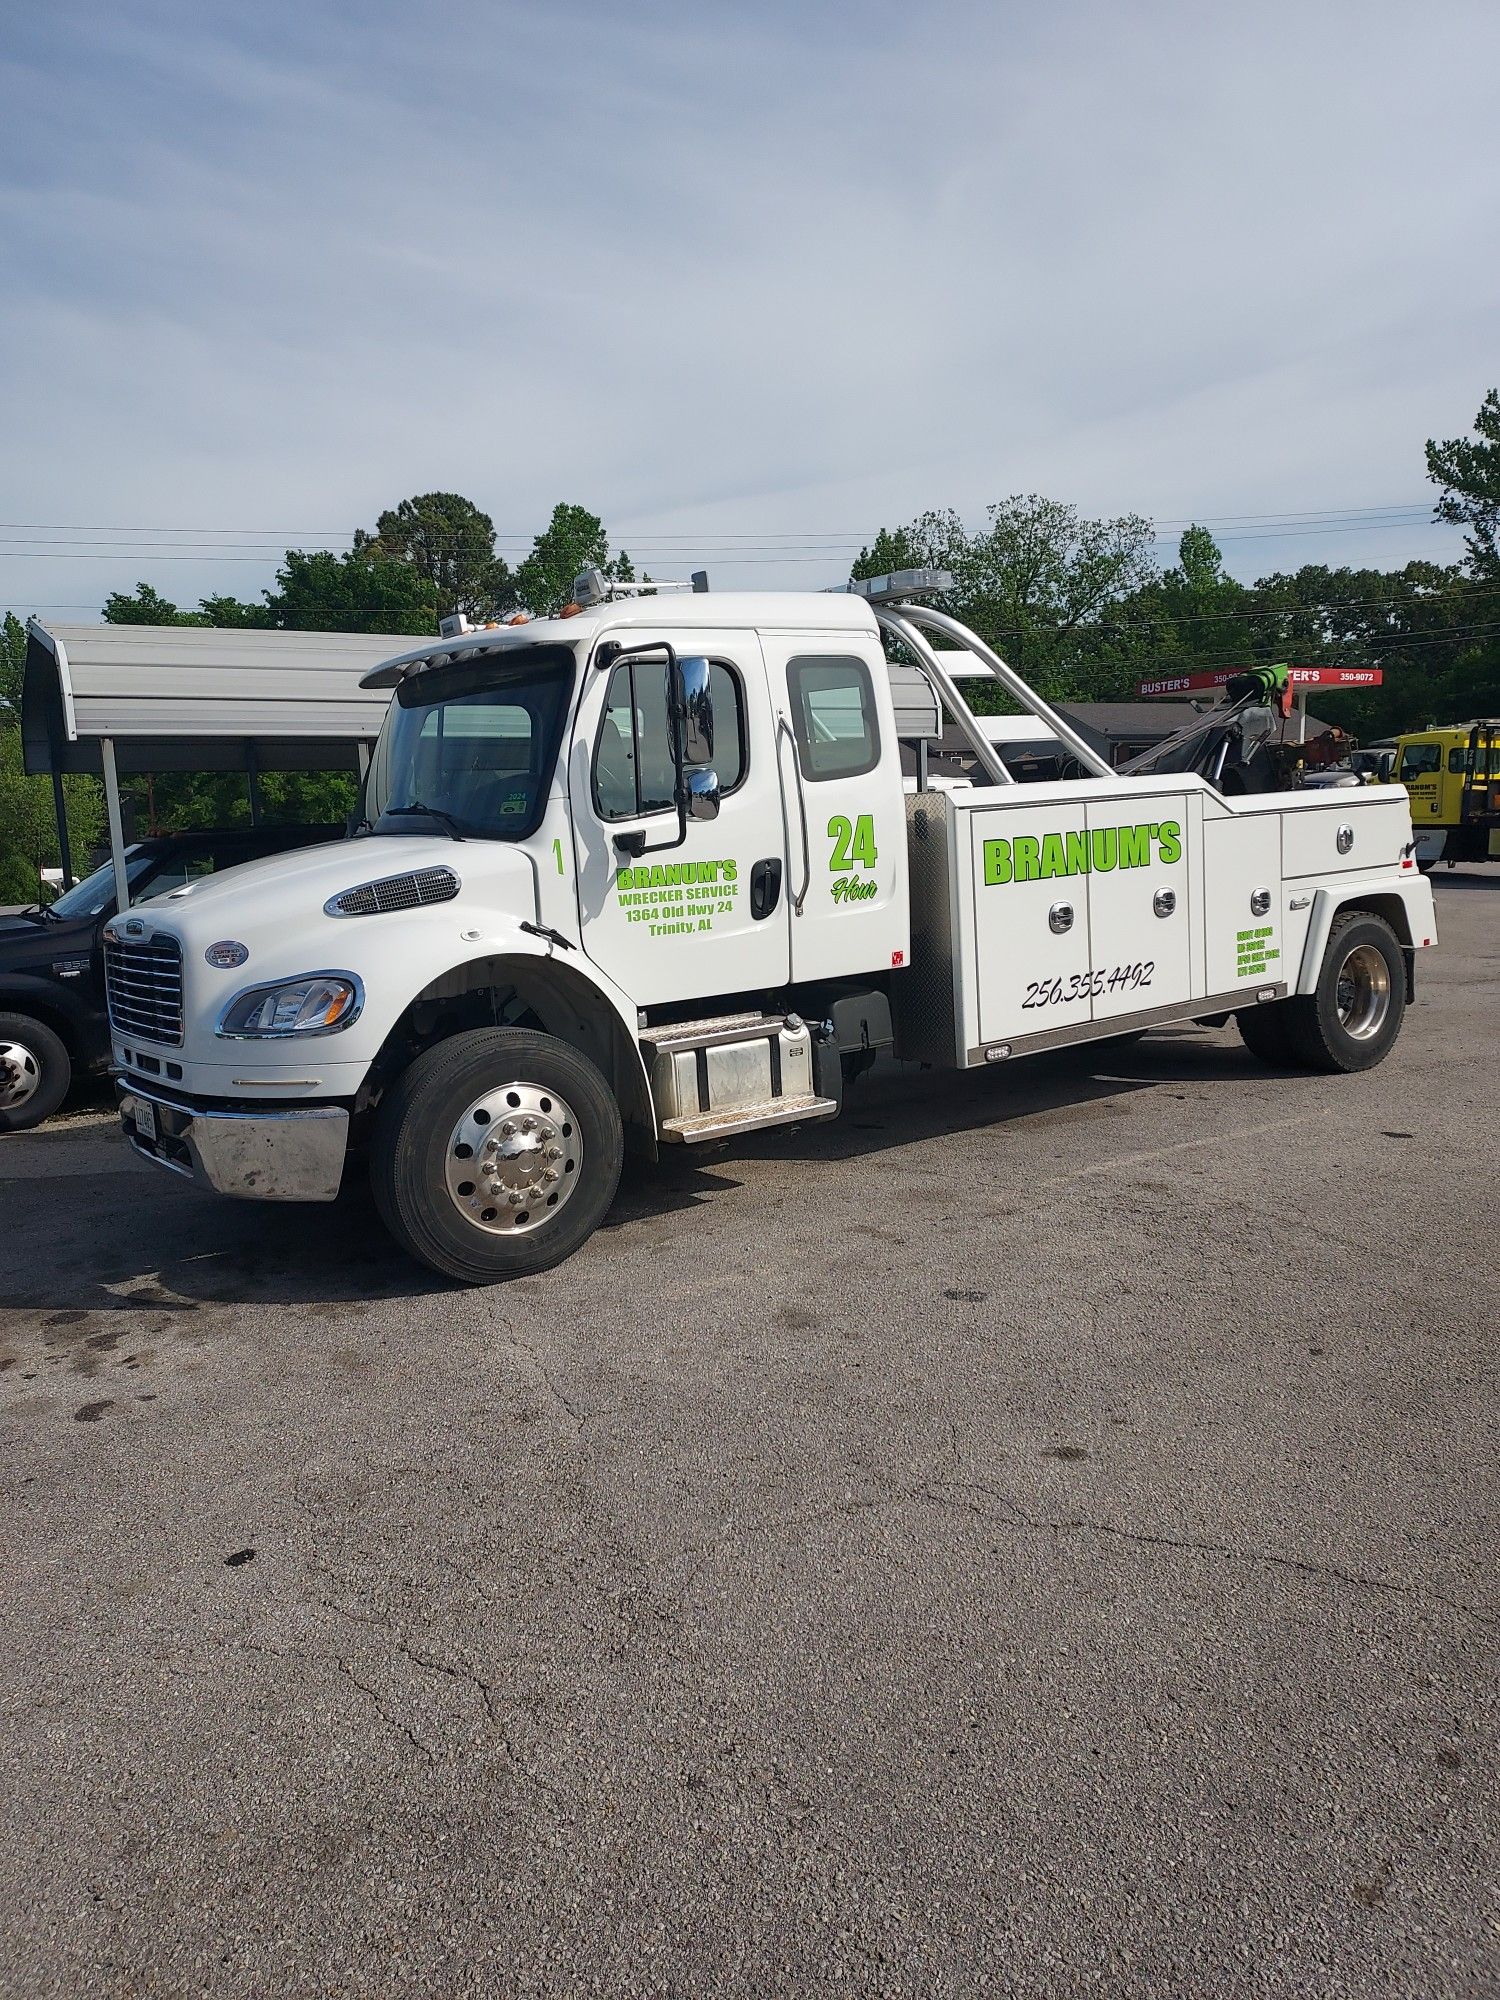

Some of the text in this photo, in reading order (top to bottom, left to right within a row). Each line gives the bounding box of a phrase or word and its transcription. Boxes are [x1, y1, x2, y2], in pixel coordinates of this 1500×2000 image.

[1141, 672, 1240, 694] BUSTER'S 350-90
[1287, 670, 1374, 681] TER'S 350-9072
[1405, 783, 1438, 791] RANUM'S
[827, 814, 878, 871] 24
[983, 820, 1182, 886] BRANUM'S
[553, 838, 564, 876] 1
[616, 859, 738, 891] BRANUM'S
[618, 884, 738, 906] WRECKER SERVICE
[831, 874, 878, 904] Hour
[625, 901, 733, 922] 1364 Old Hwy 24
[648, 918, 712, 936] Trinity, AL
[1021, 961, 1155, 1009] 256.355.4492
